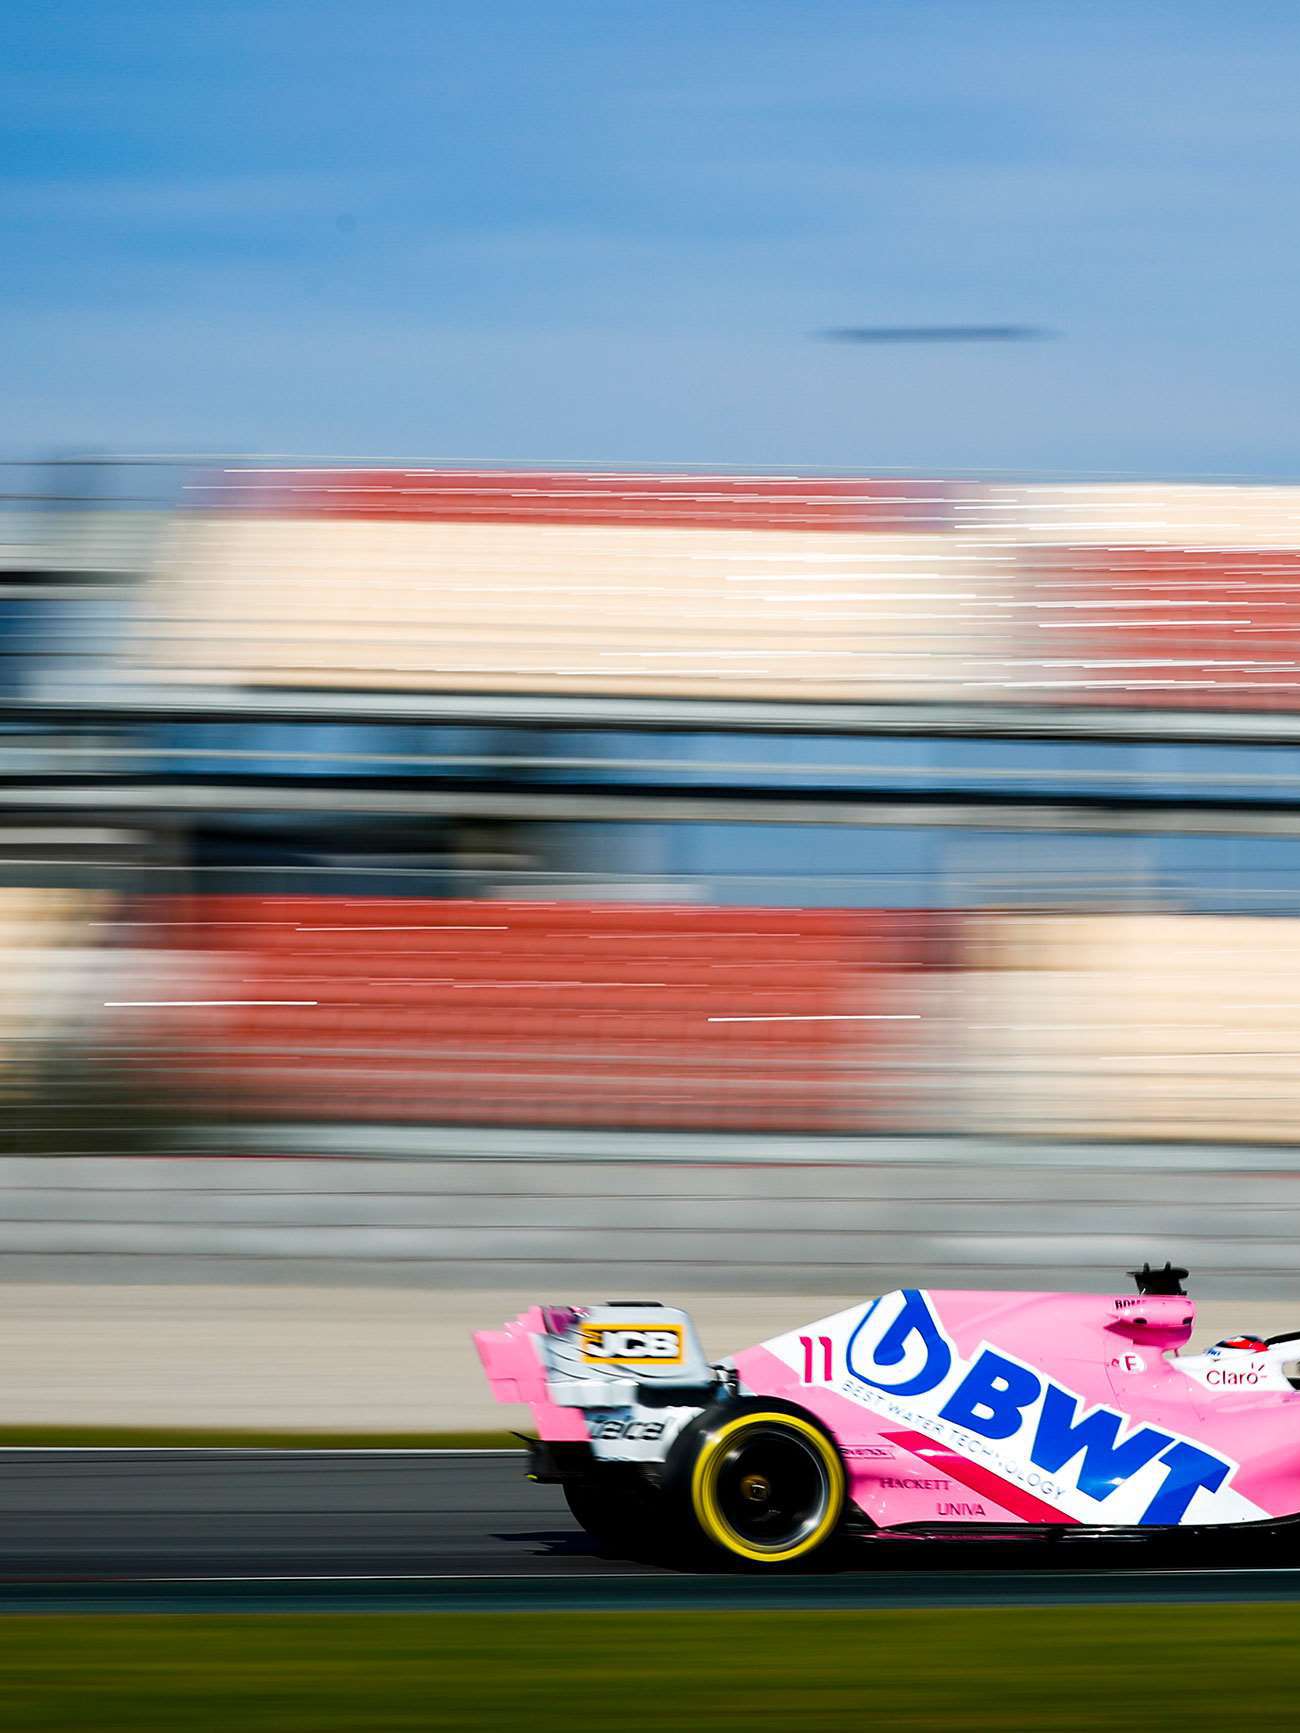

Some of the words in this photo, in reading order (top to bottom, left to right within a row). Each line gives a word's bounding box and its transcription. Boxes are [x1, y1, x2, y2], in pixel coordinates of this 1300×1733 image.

[586, 1331, 680, 1358] JCB
[799, 1336, 833, 1383] 11
[1206, 1369, 1259, 1385] Claro
[841, 1380, 886, 1406] BEST
[886, 1401, 945, 1435] WATER
[950, 1428, 1066, 1500] TECHNOLOGY
[938, 1349, 1231, 1525] BWT
[879, 1477, 950, 1490] HACKETT
[937, 1502, 986, 1516] UNIVA
